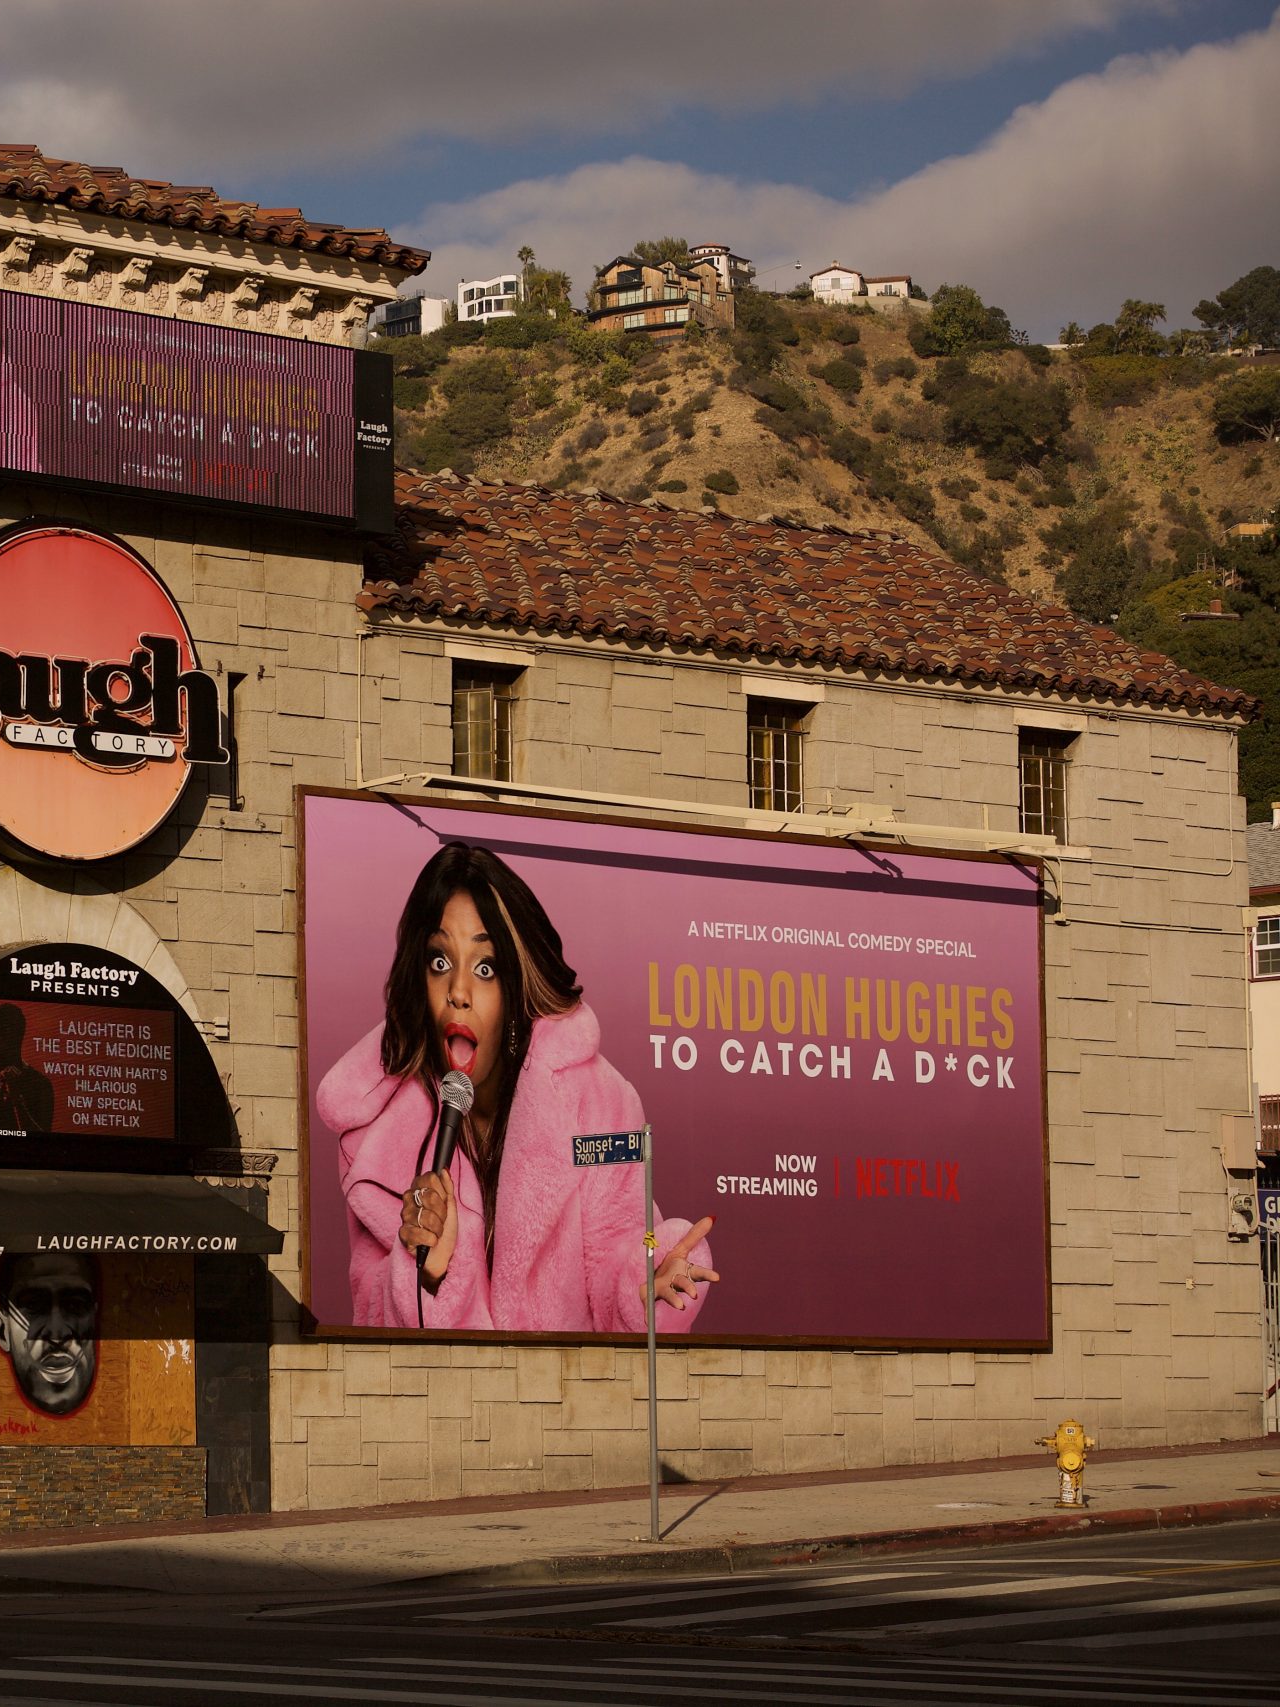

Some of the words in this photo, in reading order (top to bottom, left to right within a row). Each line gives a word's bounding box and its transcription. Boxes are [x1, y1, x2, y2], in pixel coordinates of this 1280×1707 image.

[70, 397, 102, 425] TO
[116, 405, 205, 441] CATCH
[221, 422, 235, 446] A
[360, 421, 388, 433] Laugh
[357, 432, 391, 446] Factory
[13, 725, 168, 755] FACTORY
[688, 921, 699, 936] A
[703, 922, 767, 942] NETFLIX
[771, 927, 844, 948] ORIGINAL
[848, 933, 912, 954] COMEDY
[916, 938, 976, 958] SPECIAL
[10, 958, 66, 978] Laugh
[70, 962, 139, 986] Factory
[31, 980, 120, 997] PRESENTS
[648, 962, 827, 1036] LONDON
[845, 976, 1015, 1050] HUGHES
[59, 1020, 135, 1039] LAUGHTER
[139, 1026, 151, 1040] IS
[33, 1037, 61, 1053] THE
[66, 1039, 102, 1056] BEST
[106, 1042, 171, 1060] MEDICINE
[649, 1034, 698, 1071] TO
[720, 1038, 851, 1079] CATCH
[872, 1049, 895, 1082] A
[43, 1062, 85, 1077] WATCH
[89, 1065, 122, 1079] KEVIN
[126, 1067, 167, 1081] HART'S
[75, 1080, 137, 1095] HILARIOUS
[67, 1096, 93, 1109] NEW
[98, 1098, 144, 1111] SPECIAL
[72, 1113, 90, 1125] ON
[93, 1114, 140, 1128] NETFLIX
[575, 1136, 612, 1153] Sunset
[628, 1134, 639, 1150] Bl
[576, 1153, 596, 1164] 7900
[598, 1152, 605, 1162] W
[775, 1154, 816, 1174] NOW
[716, 1175, 818, 1197] STREAMING
[856, 1157, 960, 1202] NETFLIX
[37, 1235, 238, 1251] LAUGHFACTORY.COM
